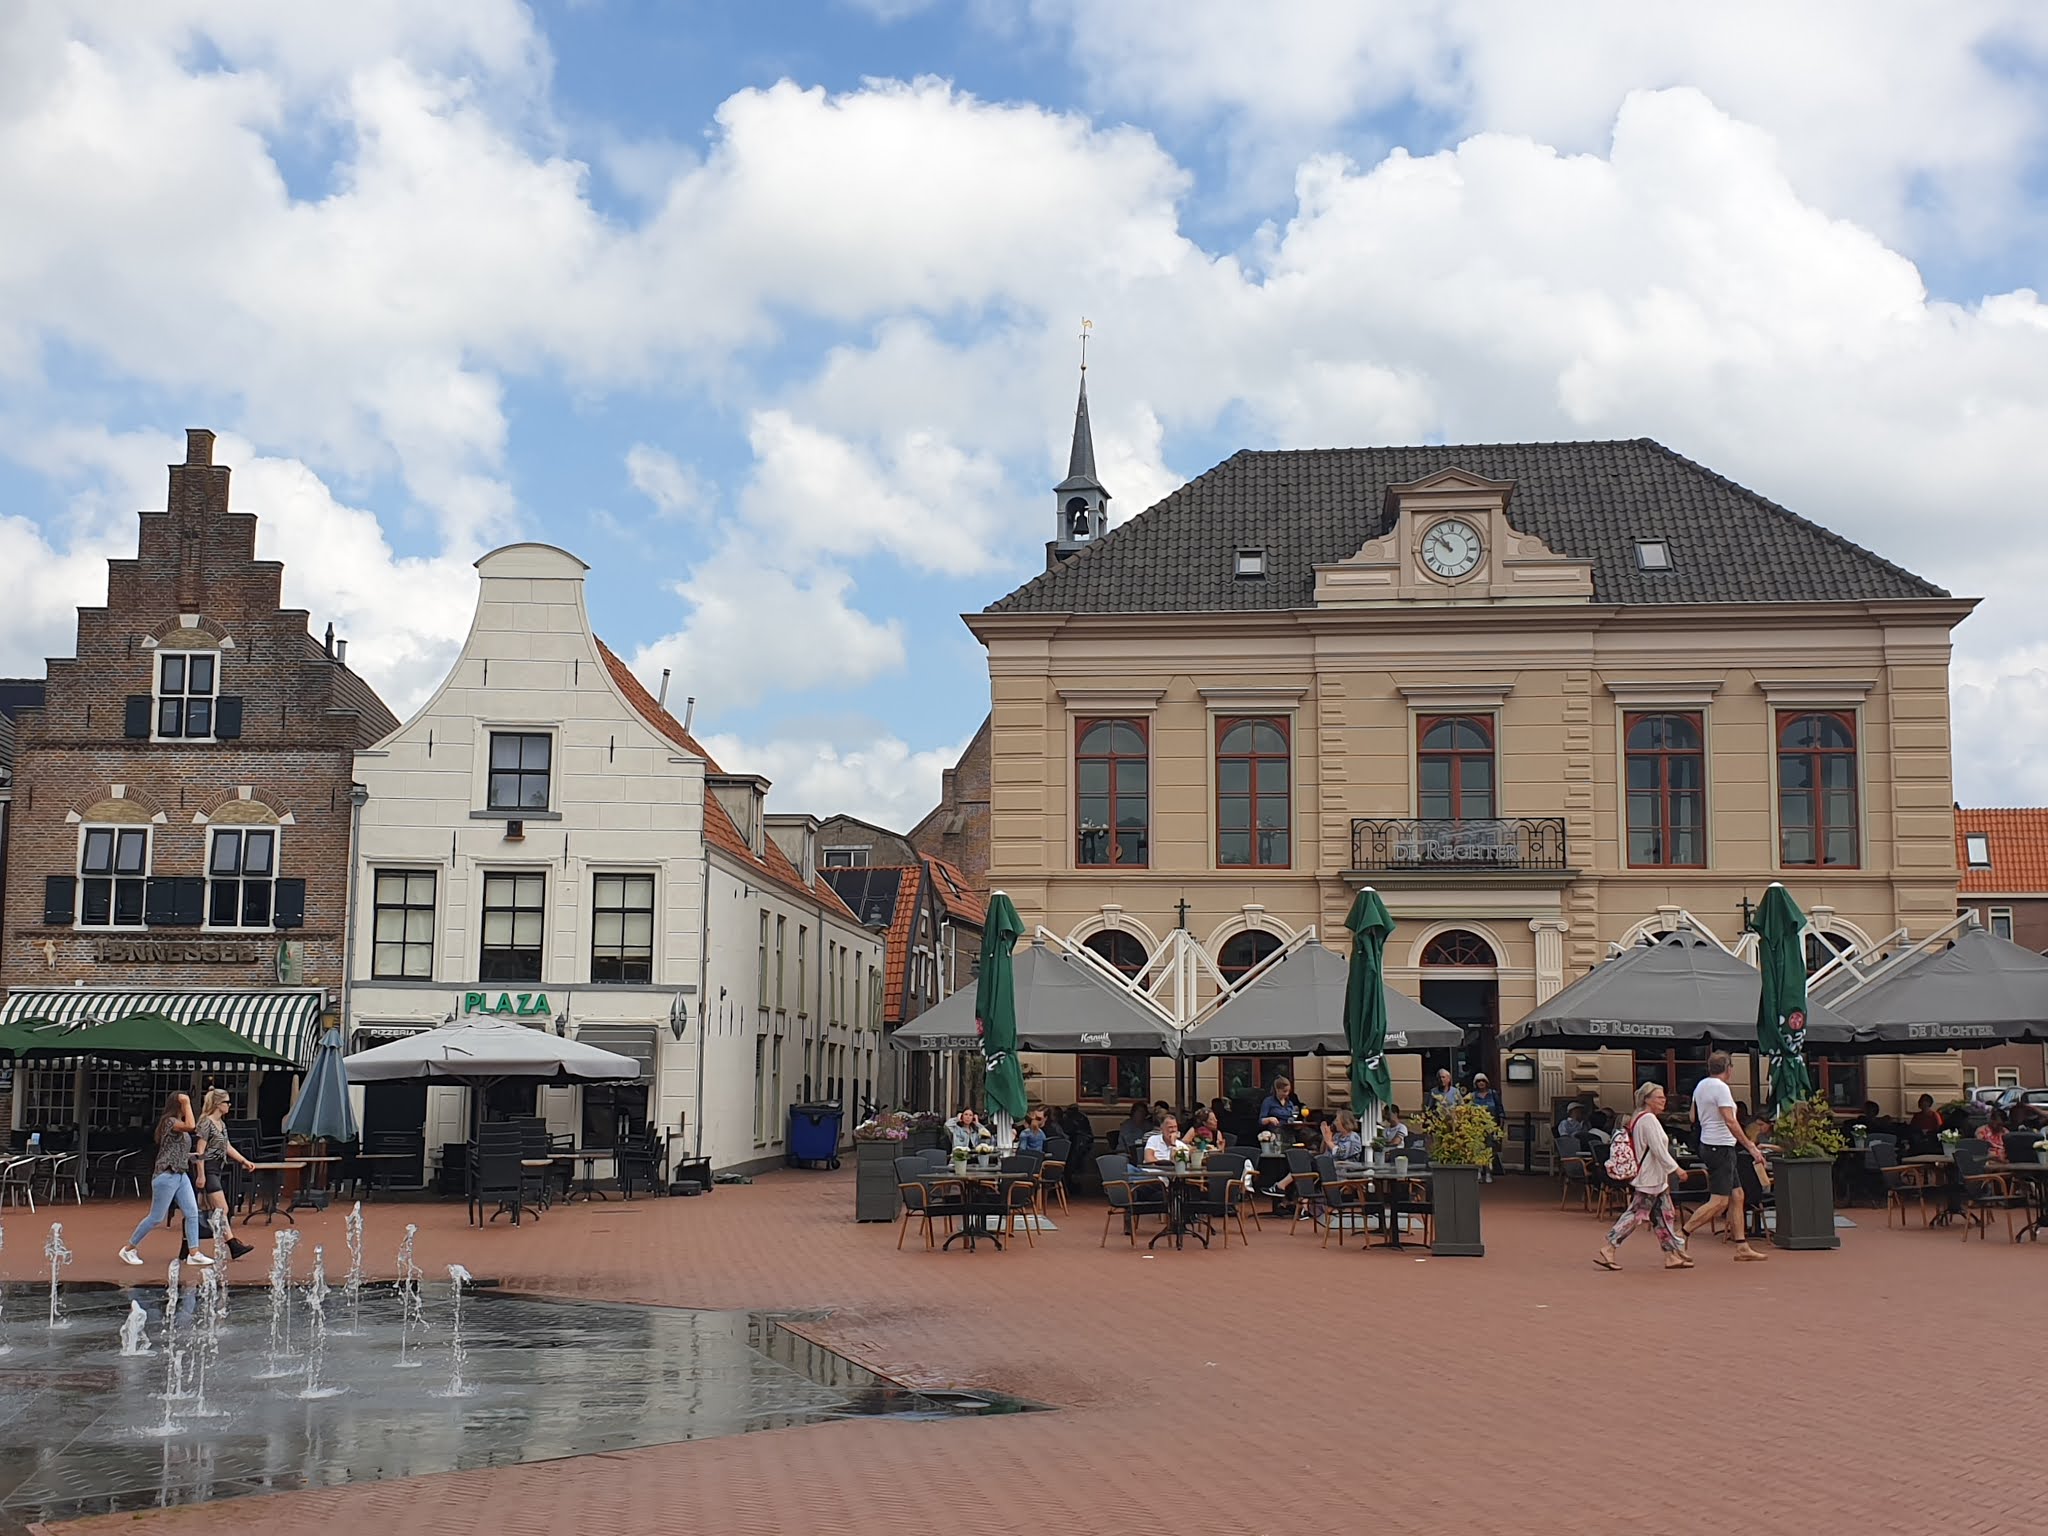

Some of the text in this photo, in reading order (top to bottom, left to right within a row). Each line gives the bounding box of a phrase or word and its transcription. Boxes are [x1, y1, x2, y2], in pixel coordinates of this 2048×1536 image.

[93, 939, 259, 964] TENNESSEE
[464, 992, 552, 1015] PLAZA
[370, 1028, 417, 1037] PIZZERIA
[1590, 1023, 1608, 1034] DE
[1908, 1026, 1927, 1037] DE
[920, 1034, 978, 1048] DE RECH
[1211, 1040, 1228, 1051] DE
